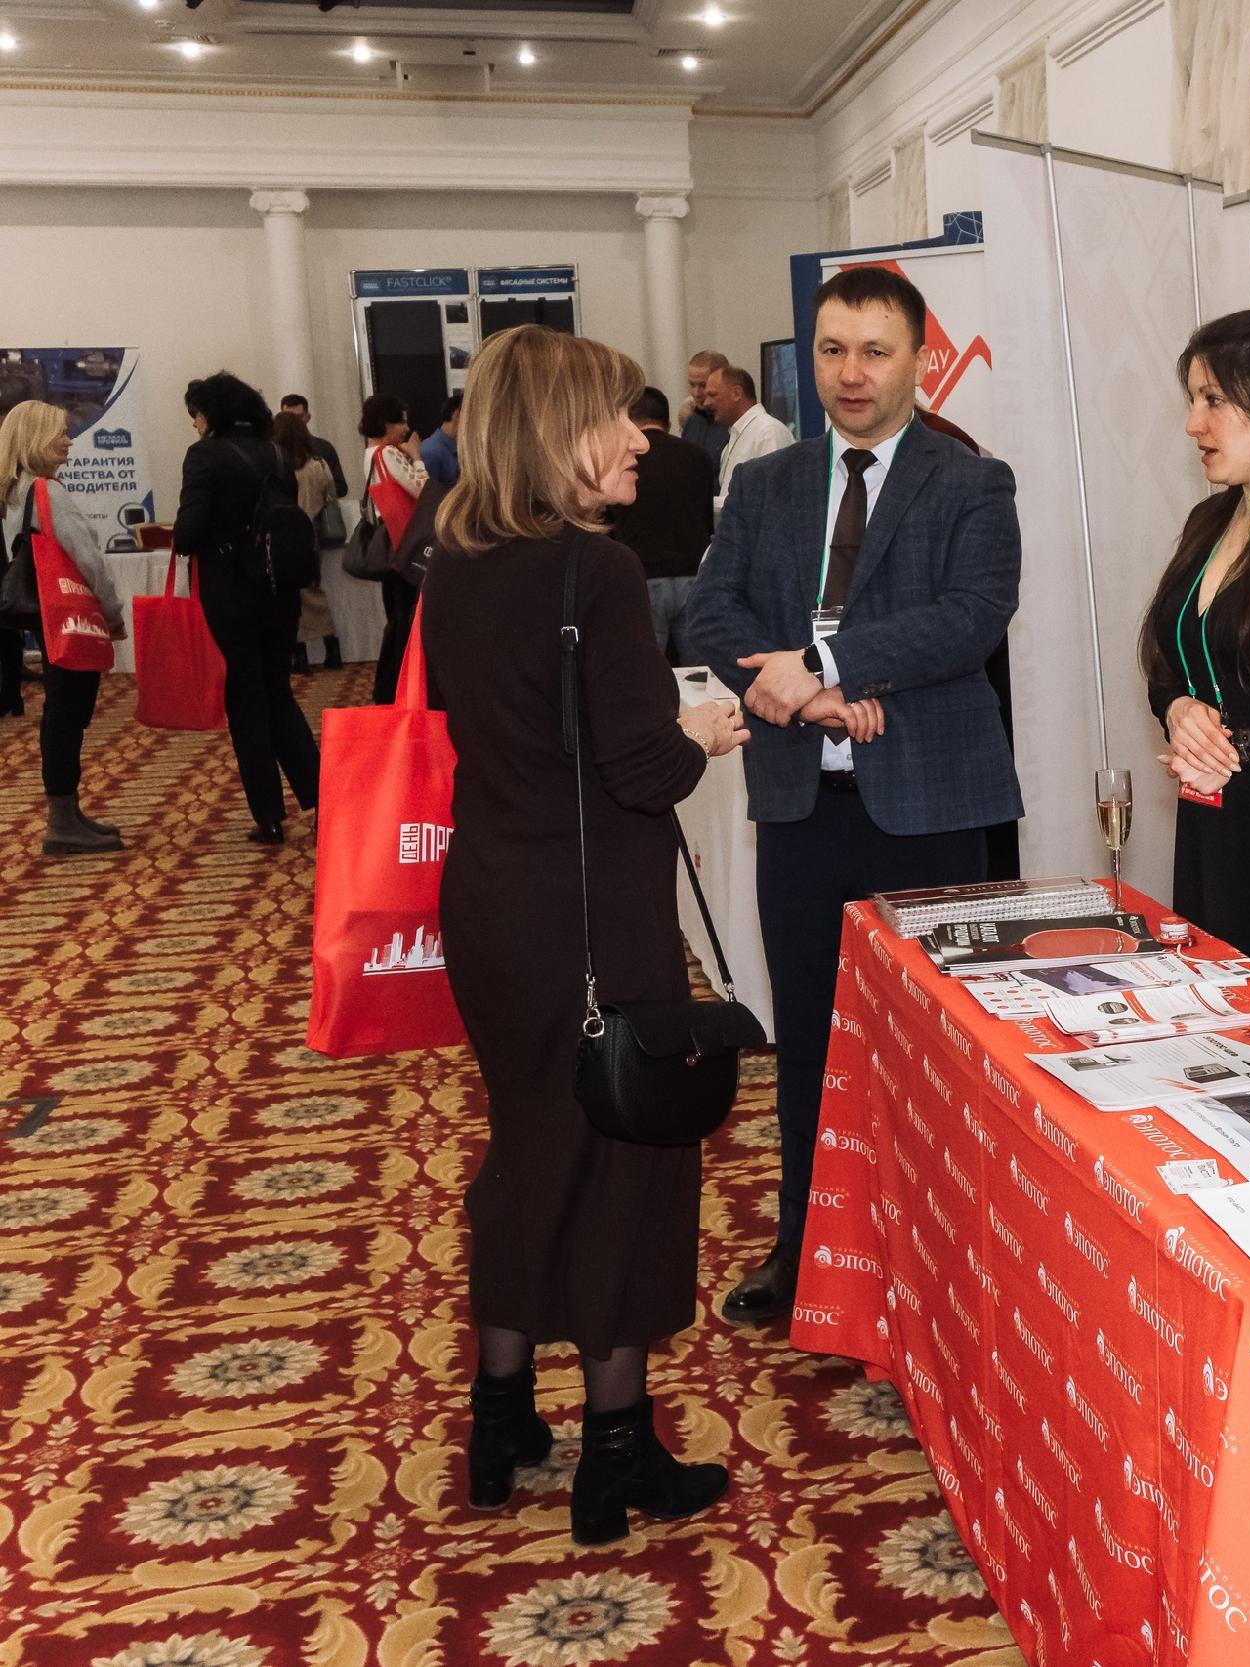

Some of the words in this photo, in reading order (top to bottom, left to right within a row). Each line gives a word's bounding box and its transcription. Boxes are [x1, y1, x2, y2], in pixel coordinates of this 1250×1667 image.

[535, 277, 568, 286] СИСТЕМЫ
[66, 456, 135, 467] ГАРАНТИЯ
[118, 469, 136, 479] ОТ
[65, 482, 137, 494] ВОДИТЕЛЯ
[992, 1058, 1021, 1109] ЭПОТОС
[1041, 1116, 1078, 1163] ЭПОТОС
[1133, 1121, 1191, 1160] ЭПОТОС
[1017, 1168, 1050, 1217] ЭПОТОС
[1103, 1170, 1145, 1224] ЭПОТОС
[1071, 1223, 1110, 1279] ЭПОТОС
[1176, 1239, 1232, 1302] ЭПОТОС
[1046, 1284, 1080, 1330] ЭПОТОС
[1135, 1293, 1185, 1356] ЭПОТОС
[1020, 1324, 1054, 1376] ЭПОТОС
[1102, 1347, 1145, 1406] ЭПОТОС
[1076, 1397, 1109, 1453] ЭПОТОС
[1023, 1466, 1057, 1530] ЭПОТОС
